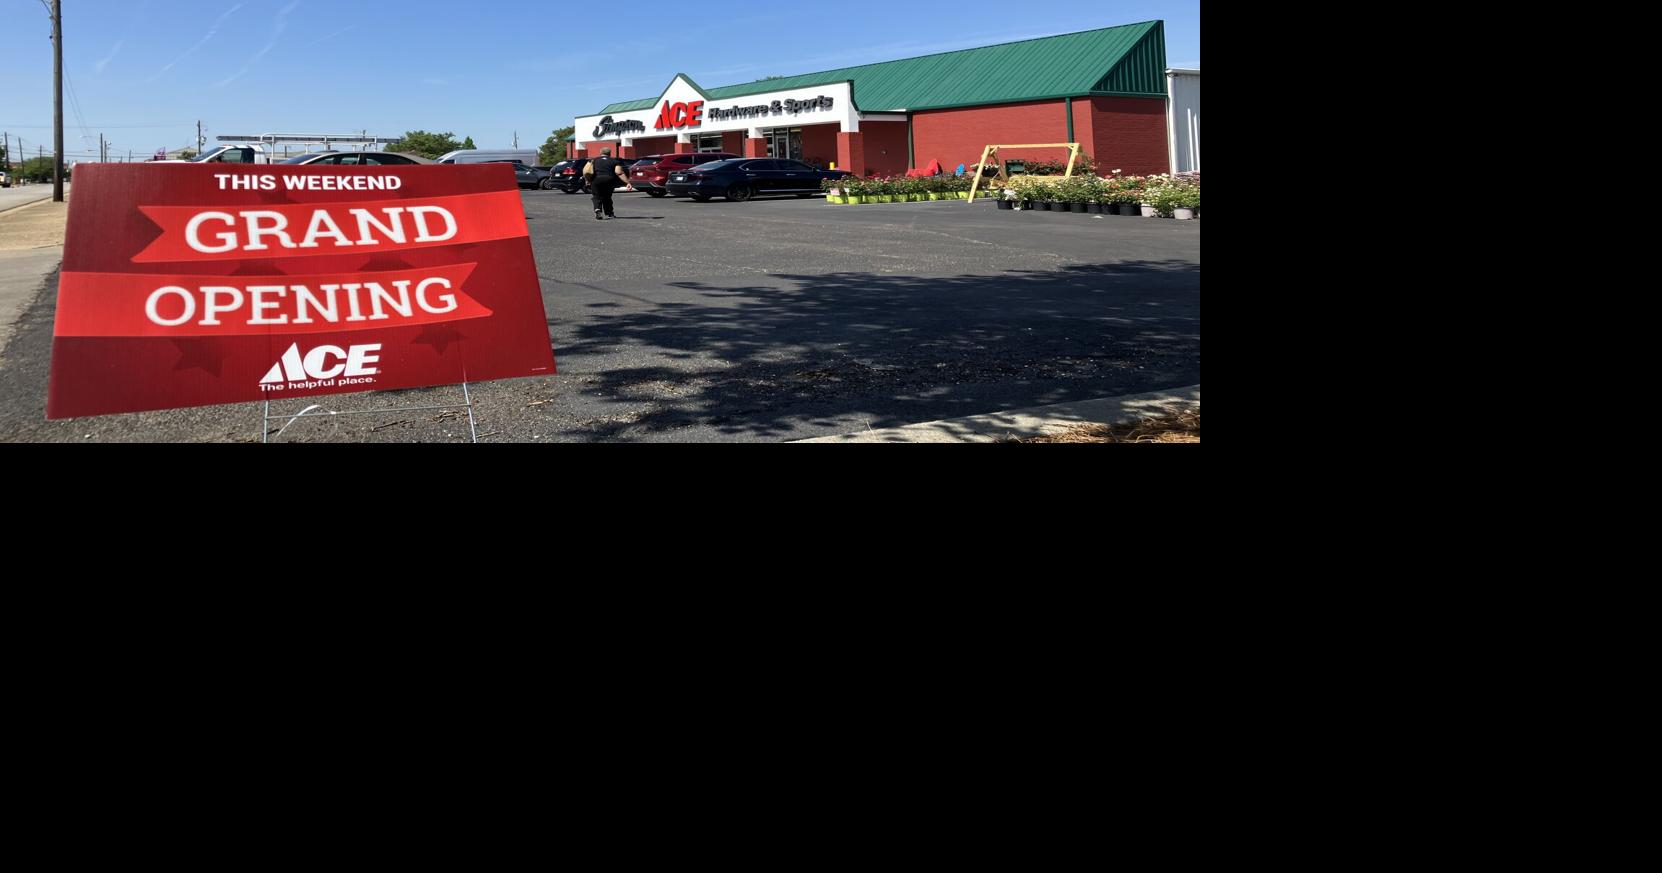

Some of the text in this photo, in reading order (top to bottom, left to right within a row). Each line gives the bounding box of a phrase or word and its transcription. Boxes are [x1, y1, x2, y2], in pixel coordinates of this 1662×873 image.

[654, 100, 704, 130] ACE
[708, 105, 768, 121] Hardware
[769, 100, 782, 114] &
[783, 96, 834, 116] Sports
[214, 174, 402, 190] THIS WEEKEND
[184, 205, 458, 254] GRAND
[145, 277, 458, 326] OPENING
[258, 341, 382, 384] ACE
[259, 376, 377, 392] The helpful place.
